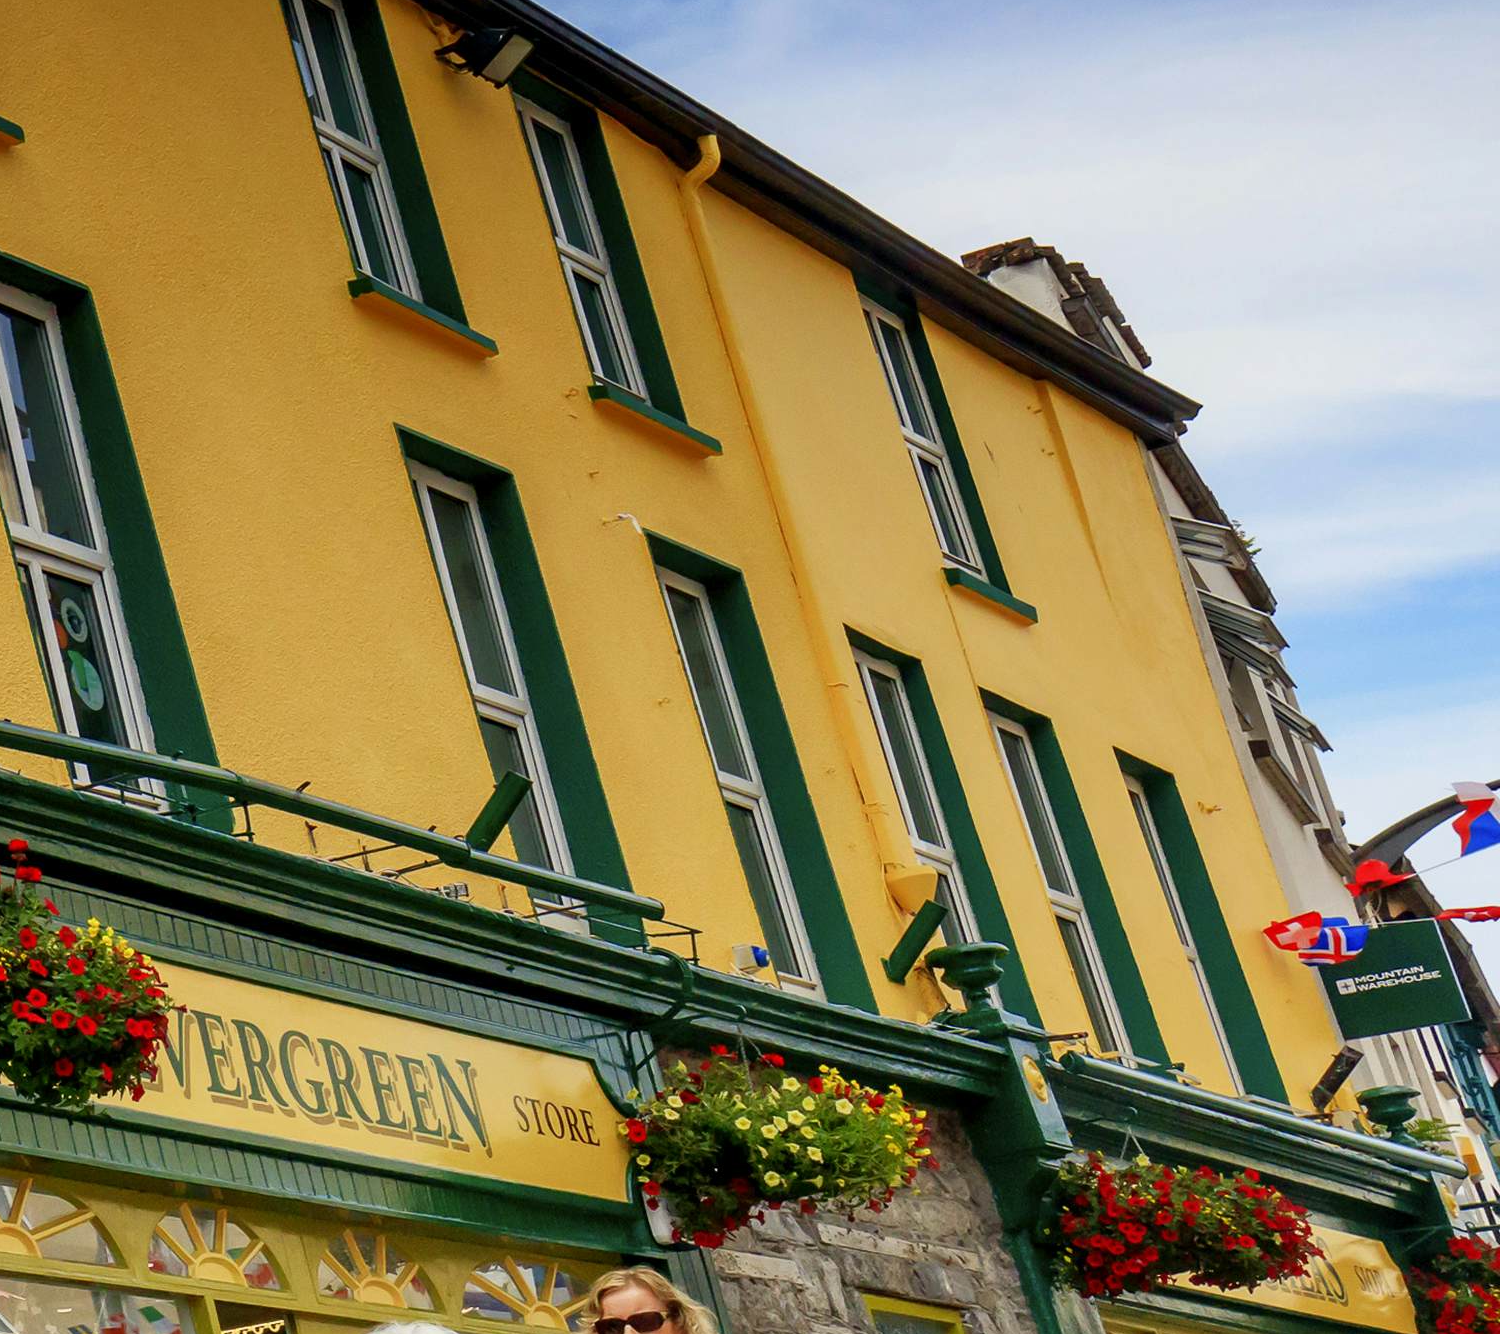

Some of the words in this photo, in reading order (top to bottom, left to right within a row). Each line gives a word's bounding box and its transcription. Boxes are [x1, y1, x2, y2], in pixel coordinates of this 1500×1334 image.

[1355, 965, 1424, 984] MOUNTAIN
[1356, 970, 1442, 992] WAREHOUSE
[150, 1005, 494, 1159] VERGREEN
[513, 1095, 600, 1147] STORE
